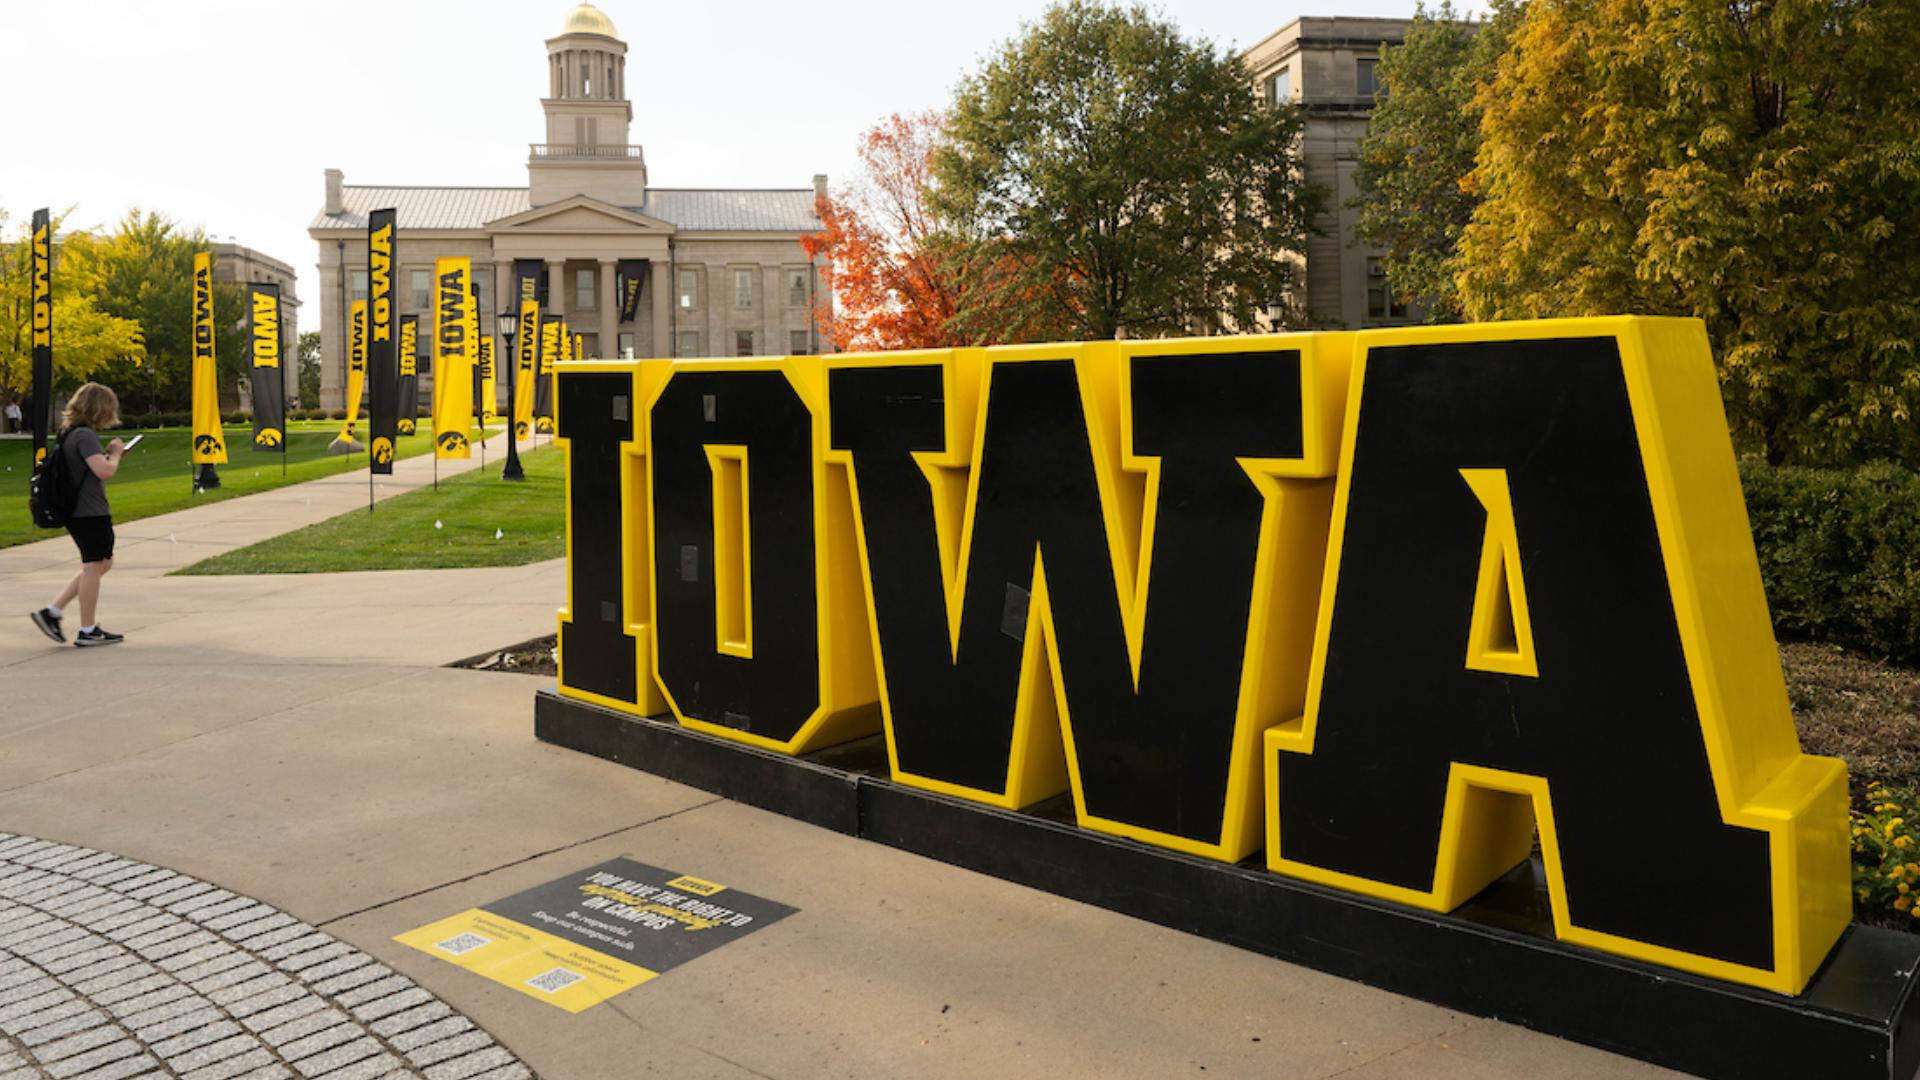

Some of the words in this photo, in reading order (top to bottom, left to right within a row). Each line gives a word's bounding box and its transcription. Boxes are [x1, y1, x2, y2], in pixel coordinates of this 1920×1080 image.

[34, 224, 50, 348] IOWA
[196, 267, 212, 357] IOWA
[370, 223, 392, 342] IOWA
[441, 268, 466, 357] IOWA
[352, 309, 363, 371] IOWA
[400, 320, 417, 376] IOWA
[521, 311, 535, 370] IOWA
[541, 321, 559, 374] IOWA
[556, 316, 1803, 996] IOWA
[581, 895, 616, 910] ON
[603, 904, 676, 930] CAMPUS
[586, 871, 625, 886] YOU
[612, 879, 661, 897] HAVE
[650, 890, 689, 906] THE
[676, 899, 735, 919] RIGHT
[723, 913, 754, 928] TO
